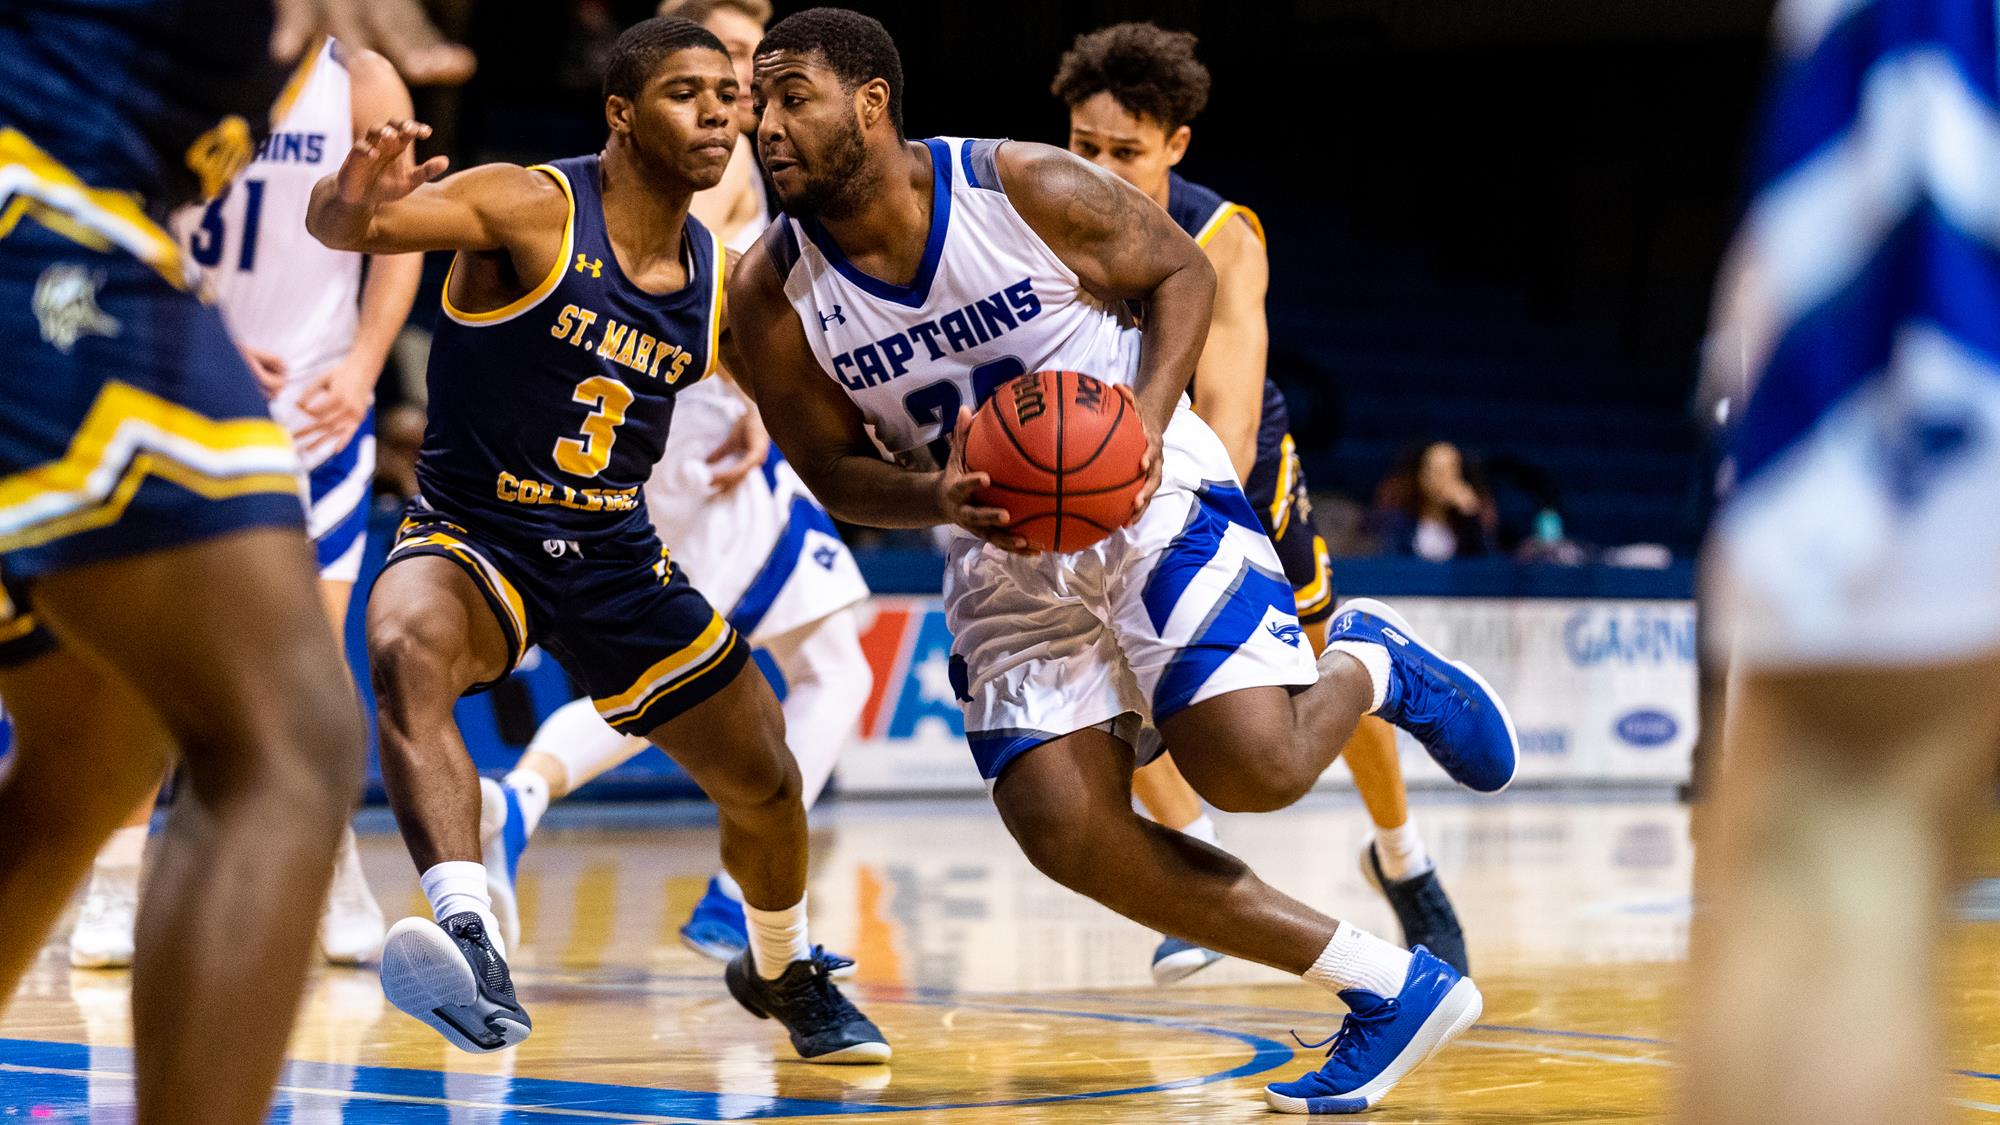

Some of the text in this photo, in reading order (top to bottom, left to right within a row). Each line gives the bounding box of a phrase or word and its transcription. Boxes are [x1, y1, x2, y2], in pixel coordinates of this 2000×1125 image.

[190, 180, 266, 271] 31
[551, 304, 692, 385] ST. MARY'S
[832, 277, 1042, 391] CAPTAINS
[553, 375, 634, 478] 3
